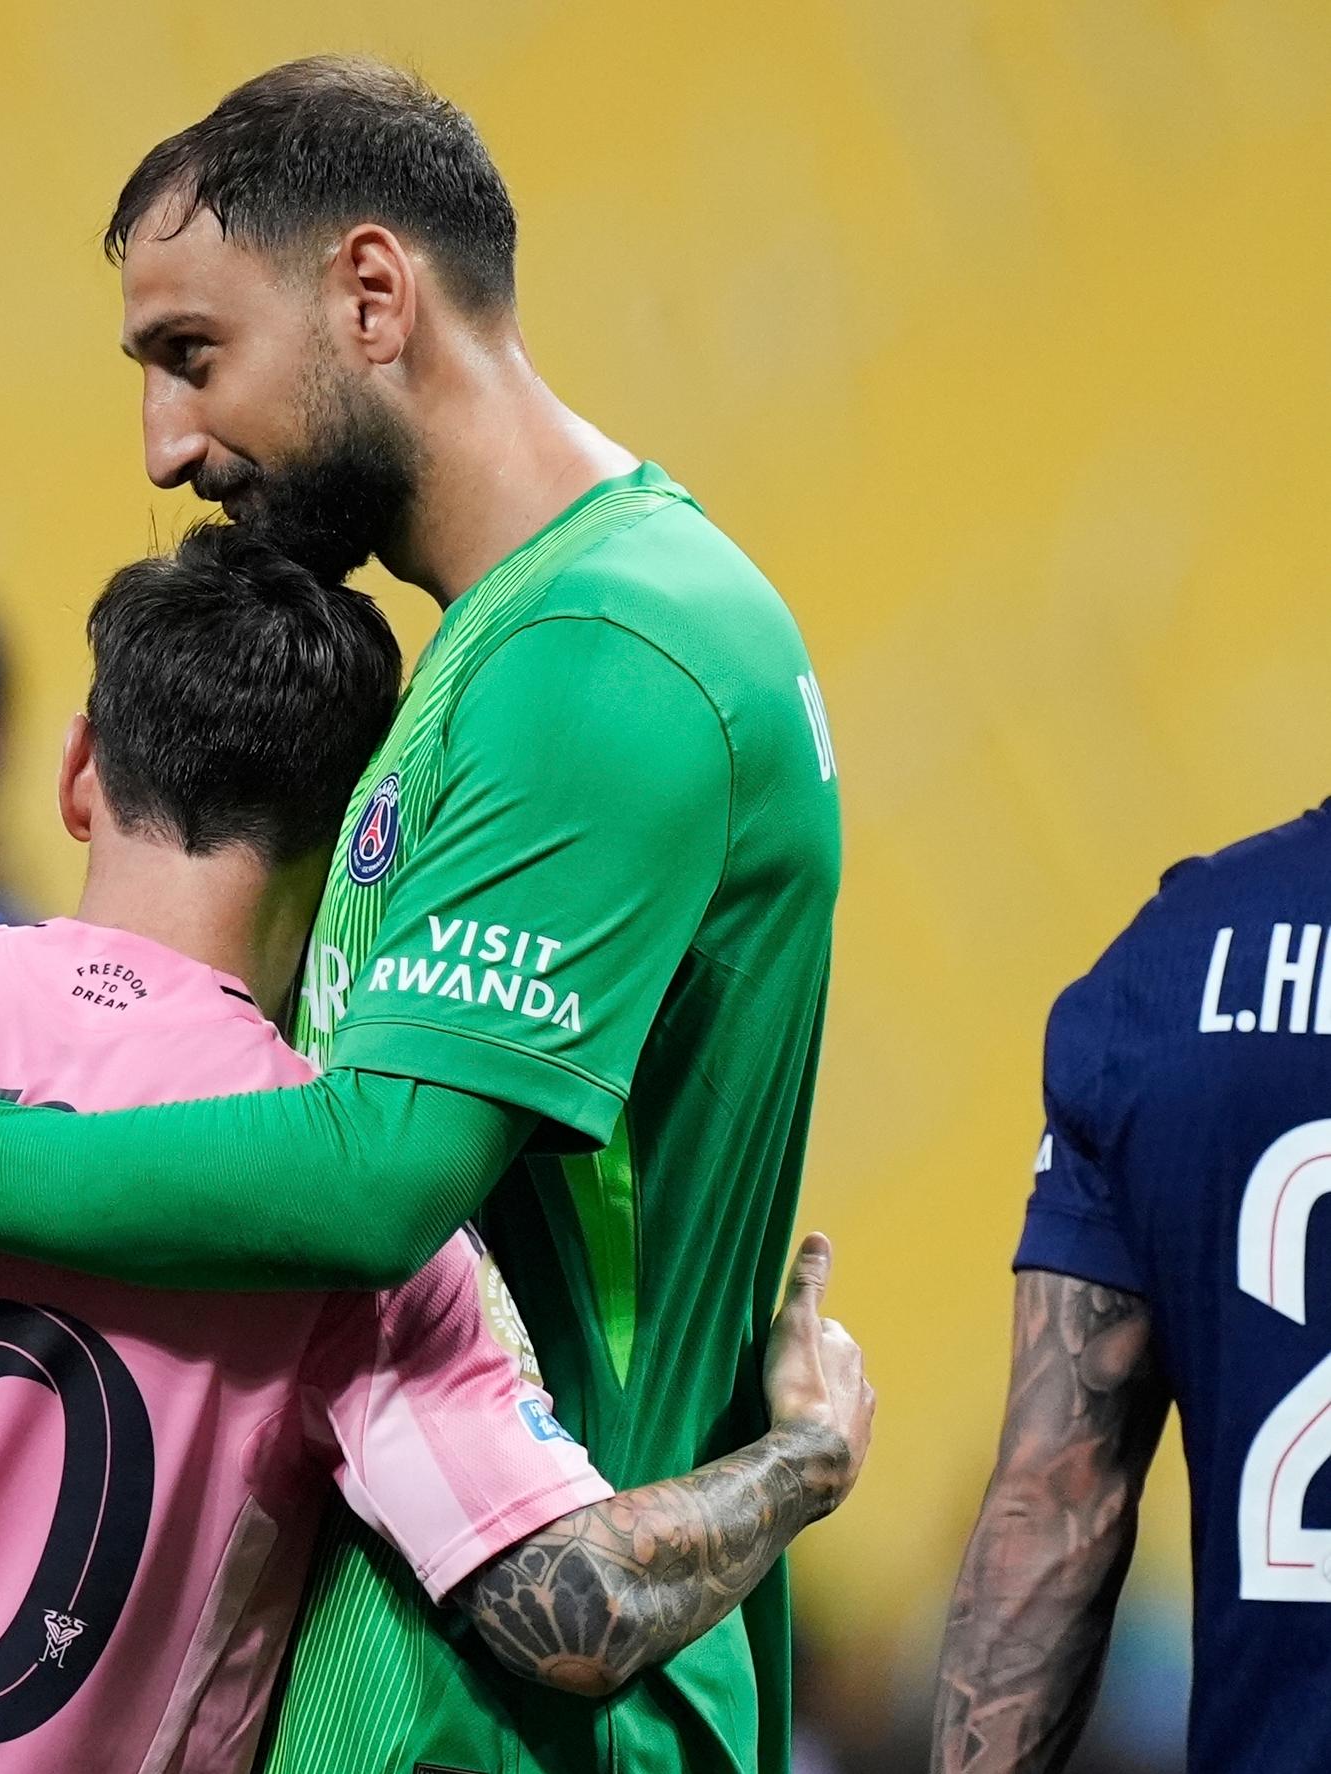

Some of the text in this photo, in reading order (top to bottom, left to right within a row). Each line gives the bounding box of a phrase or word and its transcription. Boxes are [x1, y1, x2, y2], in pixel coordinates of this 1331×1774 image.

[428, 915, 562, 973] VISIT
[72, 986, 128, 1011] DREAM
[76, 963, 147, 999] FREEDOM
[101, 981, 118, 993] TO
[368, 957, 582, 1033] RWANDA
